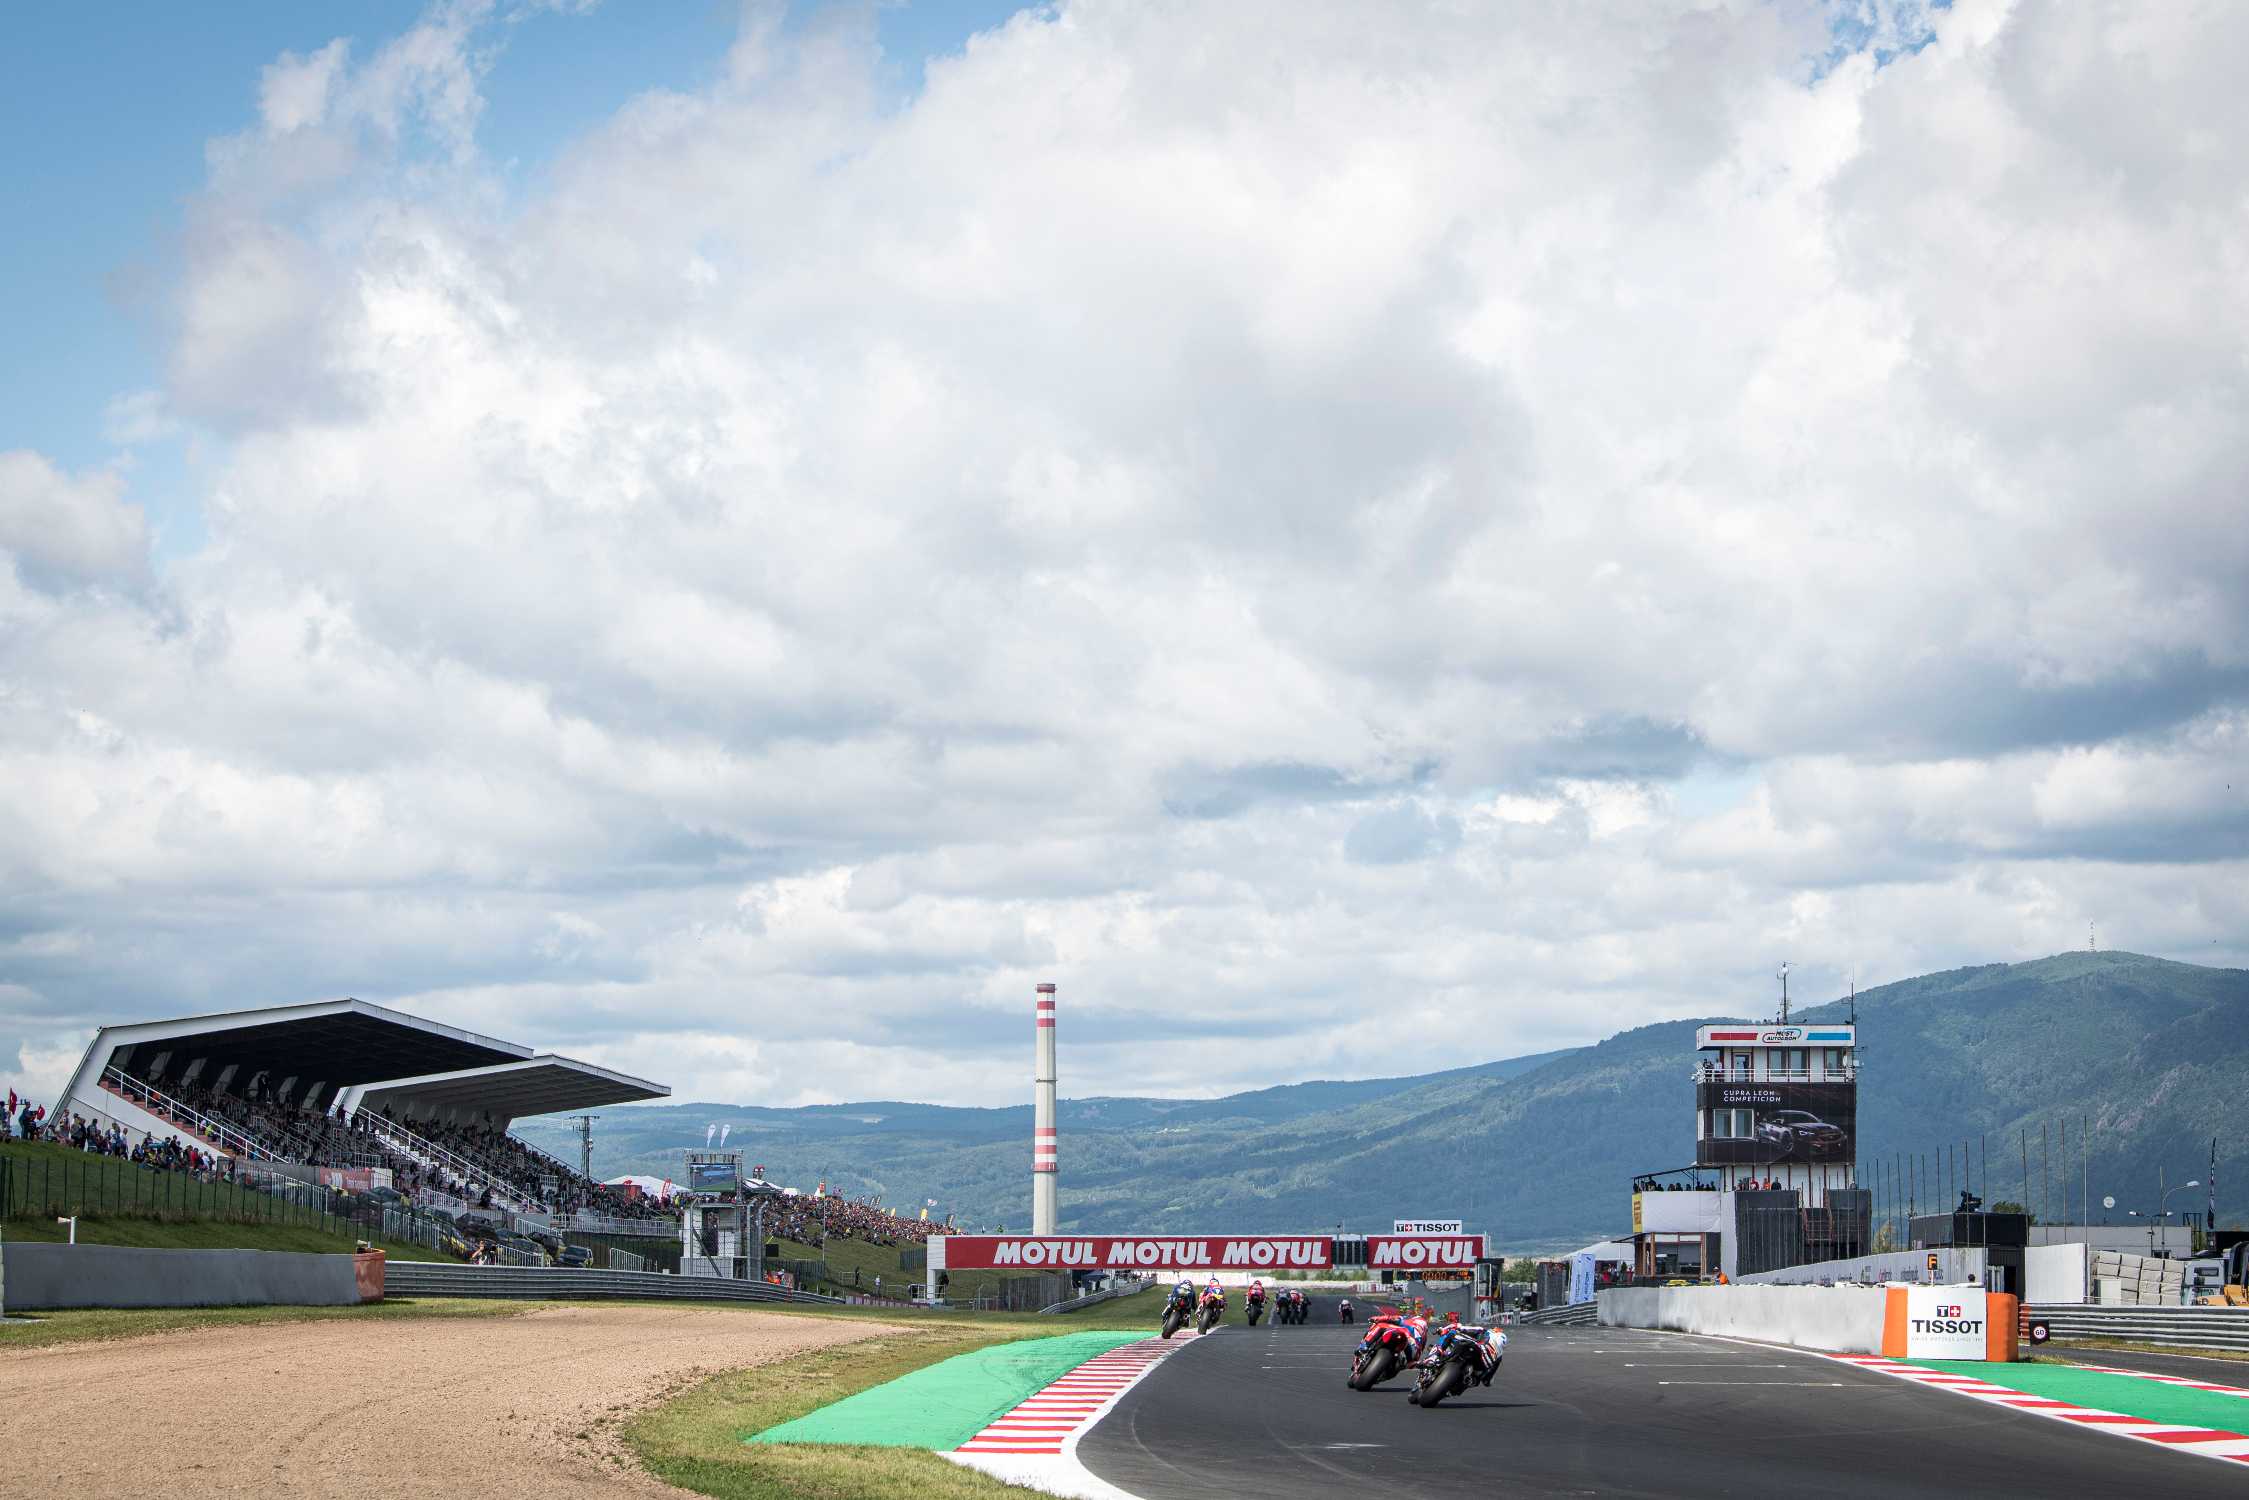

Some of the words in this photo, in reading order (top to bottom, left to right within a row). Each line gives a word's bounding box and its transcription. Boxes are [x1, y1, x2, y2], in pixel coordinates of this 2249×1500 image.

[1414, 1223, 1459, 1232] TISSOT
[993, 1242, 1097, 1265] MOTUL
[1107, 1242, 1211, 1265] MOTUL
[1222, 1241, 1326, 1265] MOTUL
[1373, 1241, 1477, 1264] MOTUL
[1928, 1255, 1937, 1268] F
[1911, 1319, 1982, 1334] TISSOT
